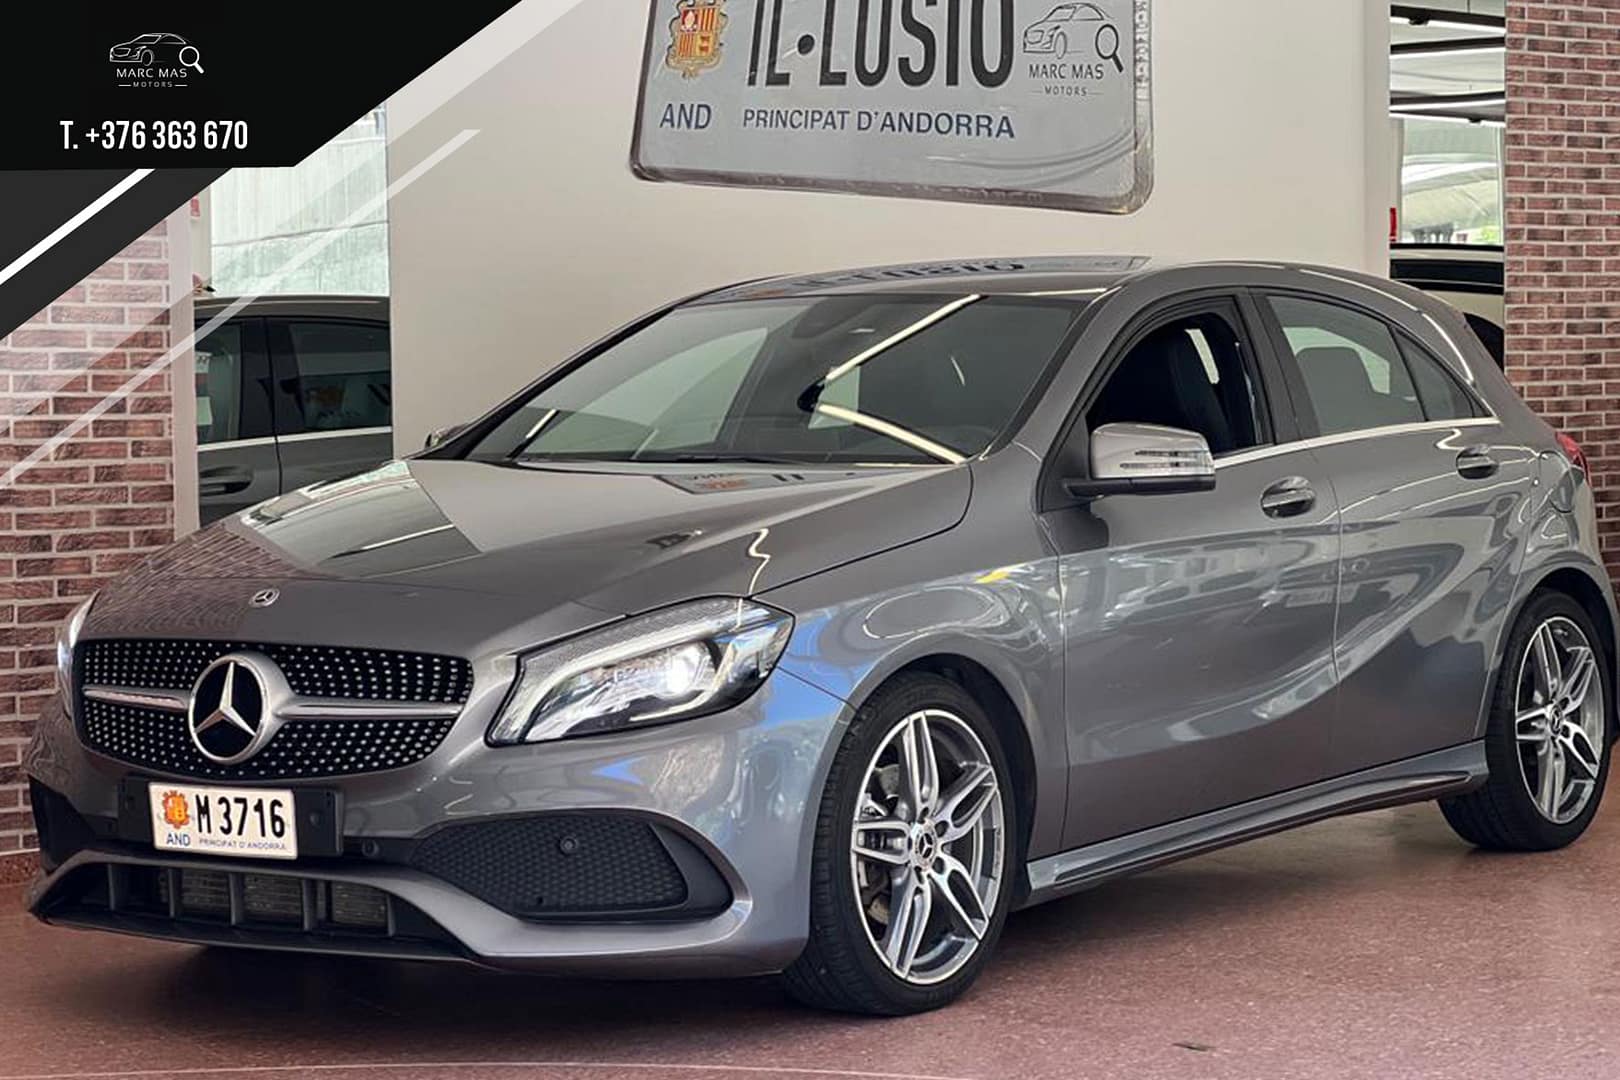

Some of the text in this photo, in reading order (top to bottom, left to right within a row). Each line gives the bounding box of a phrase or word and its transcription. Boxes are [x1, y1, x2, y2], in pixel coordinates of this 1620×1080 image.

[1028, 63, 1104, 80] MARC MAS
[1044, 86, 1087, 97] MOTORS
[659, 103, 712, 130] AND
[743, 109, 1015, 138] PRINCIPAT D'ANDORRA
[217, 796, 285, 838] 3716
[166, 832, 191, 847] AND
